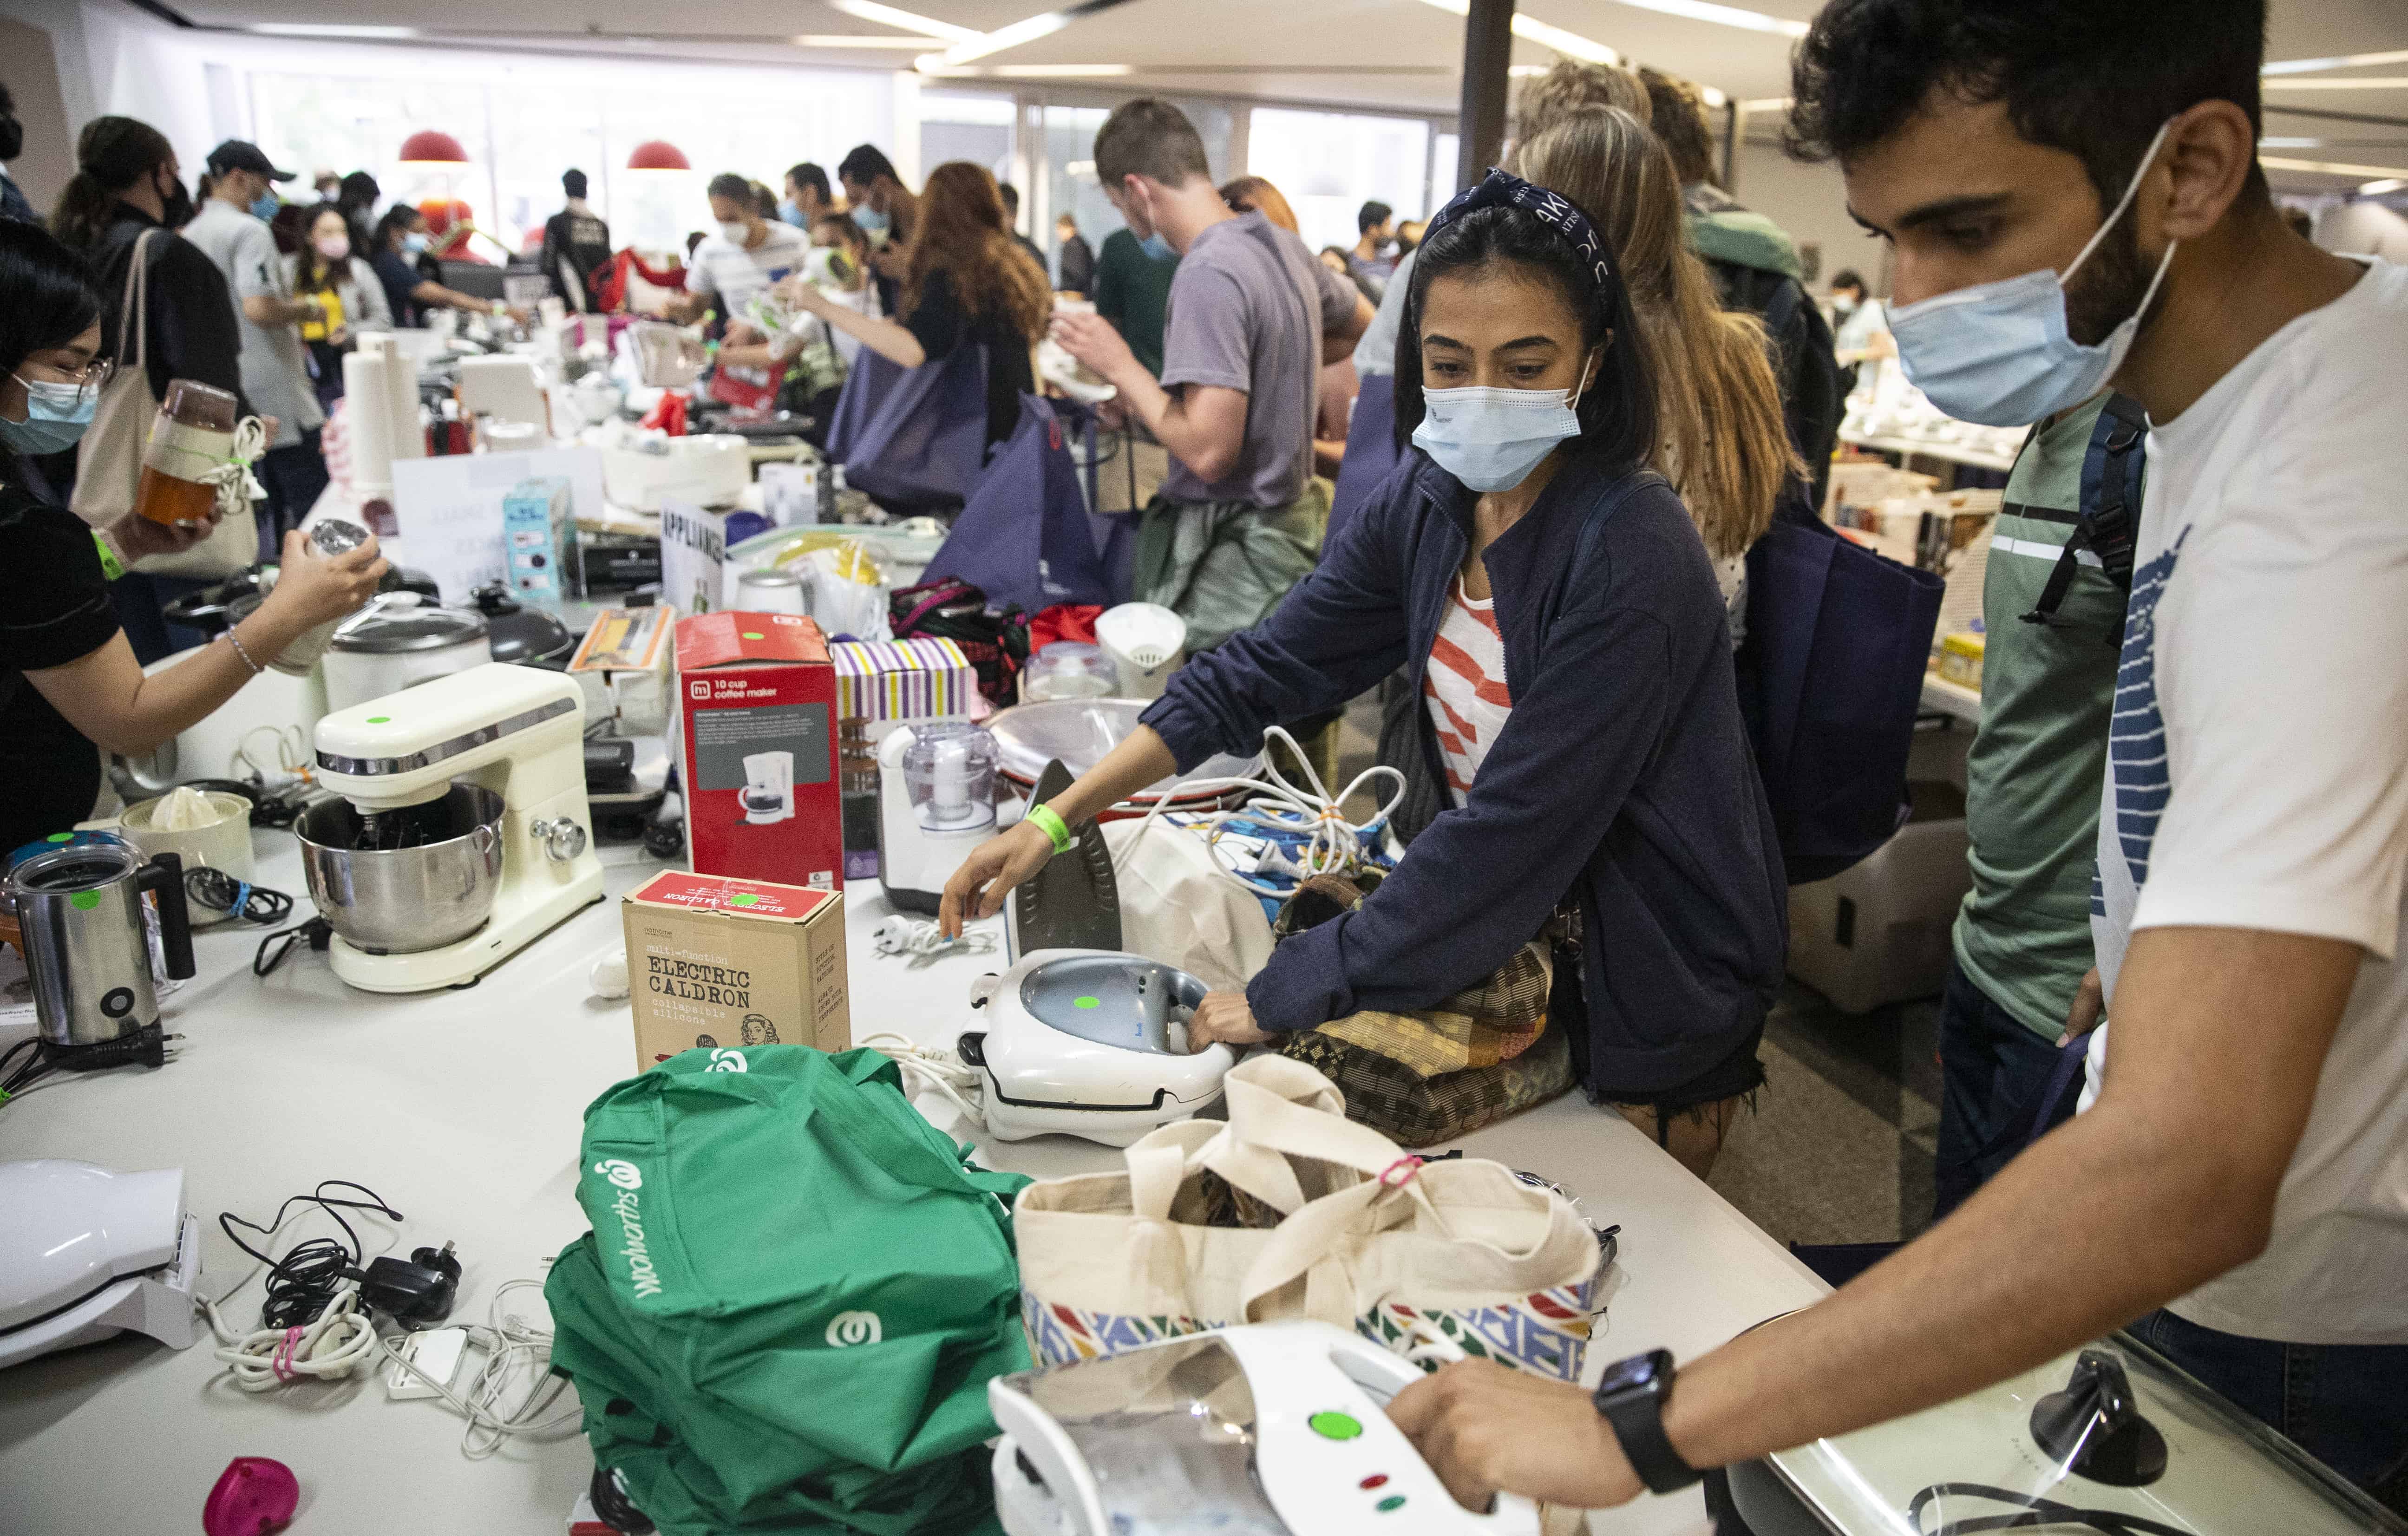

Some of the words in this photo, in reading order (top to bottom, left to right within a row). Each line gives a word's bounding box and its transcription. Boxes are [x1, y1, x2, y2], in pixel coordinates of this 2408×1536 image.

[714, 680, 726, 689] 10
[714, 690, 745, 699] coffee
[746, 688, 778, 697] maker
[647, 945, 728, 965] multi-function
[647, 955, 750, 988] ELECTRIC
[649, 975, 750, 1008] CALDRON
[652, 999, 725, 1019] collapsible
[654, 1009, 706, 1025] silicone
[611, 1190, 662, 1299] Woolworths
